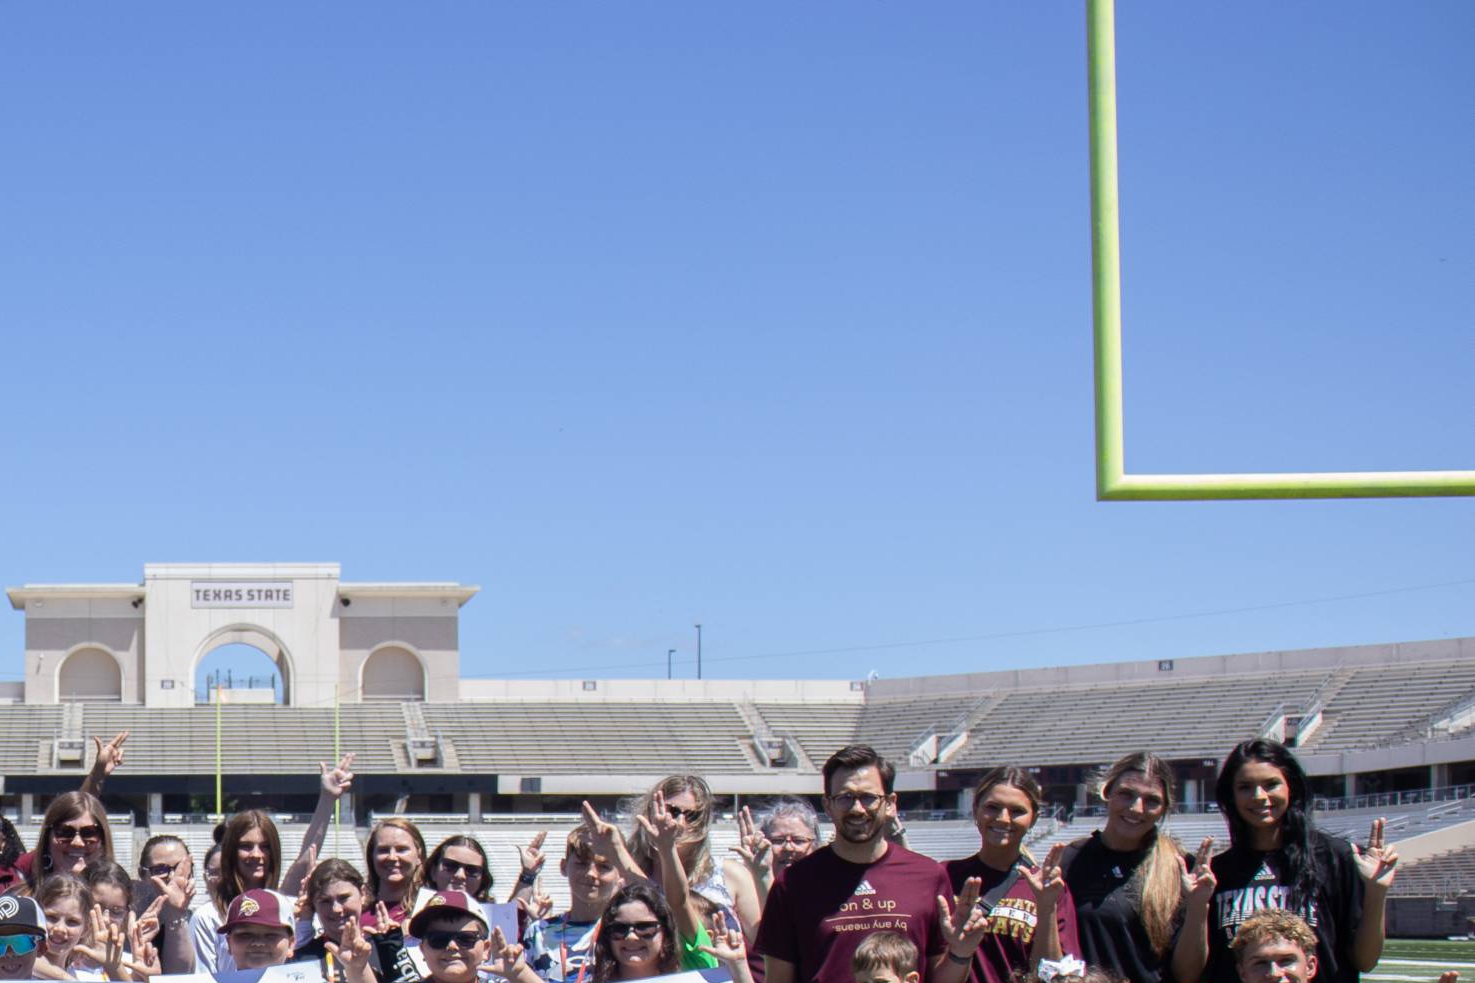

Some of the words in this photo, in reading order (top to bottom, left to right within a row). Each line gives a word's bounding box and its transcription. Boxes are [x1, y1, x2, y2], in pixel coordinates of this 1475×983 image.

[194, 589, 243, 601] TEXAS
[247, 589, 291, 601] STATE
[839, 902, 858, 912] on
[862, 898, 873, 910] &
[877, 900, 896, 912] up
